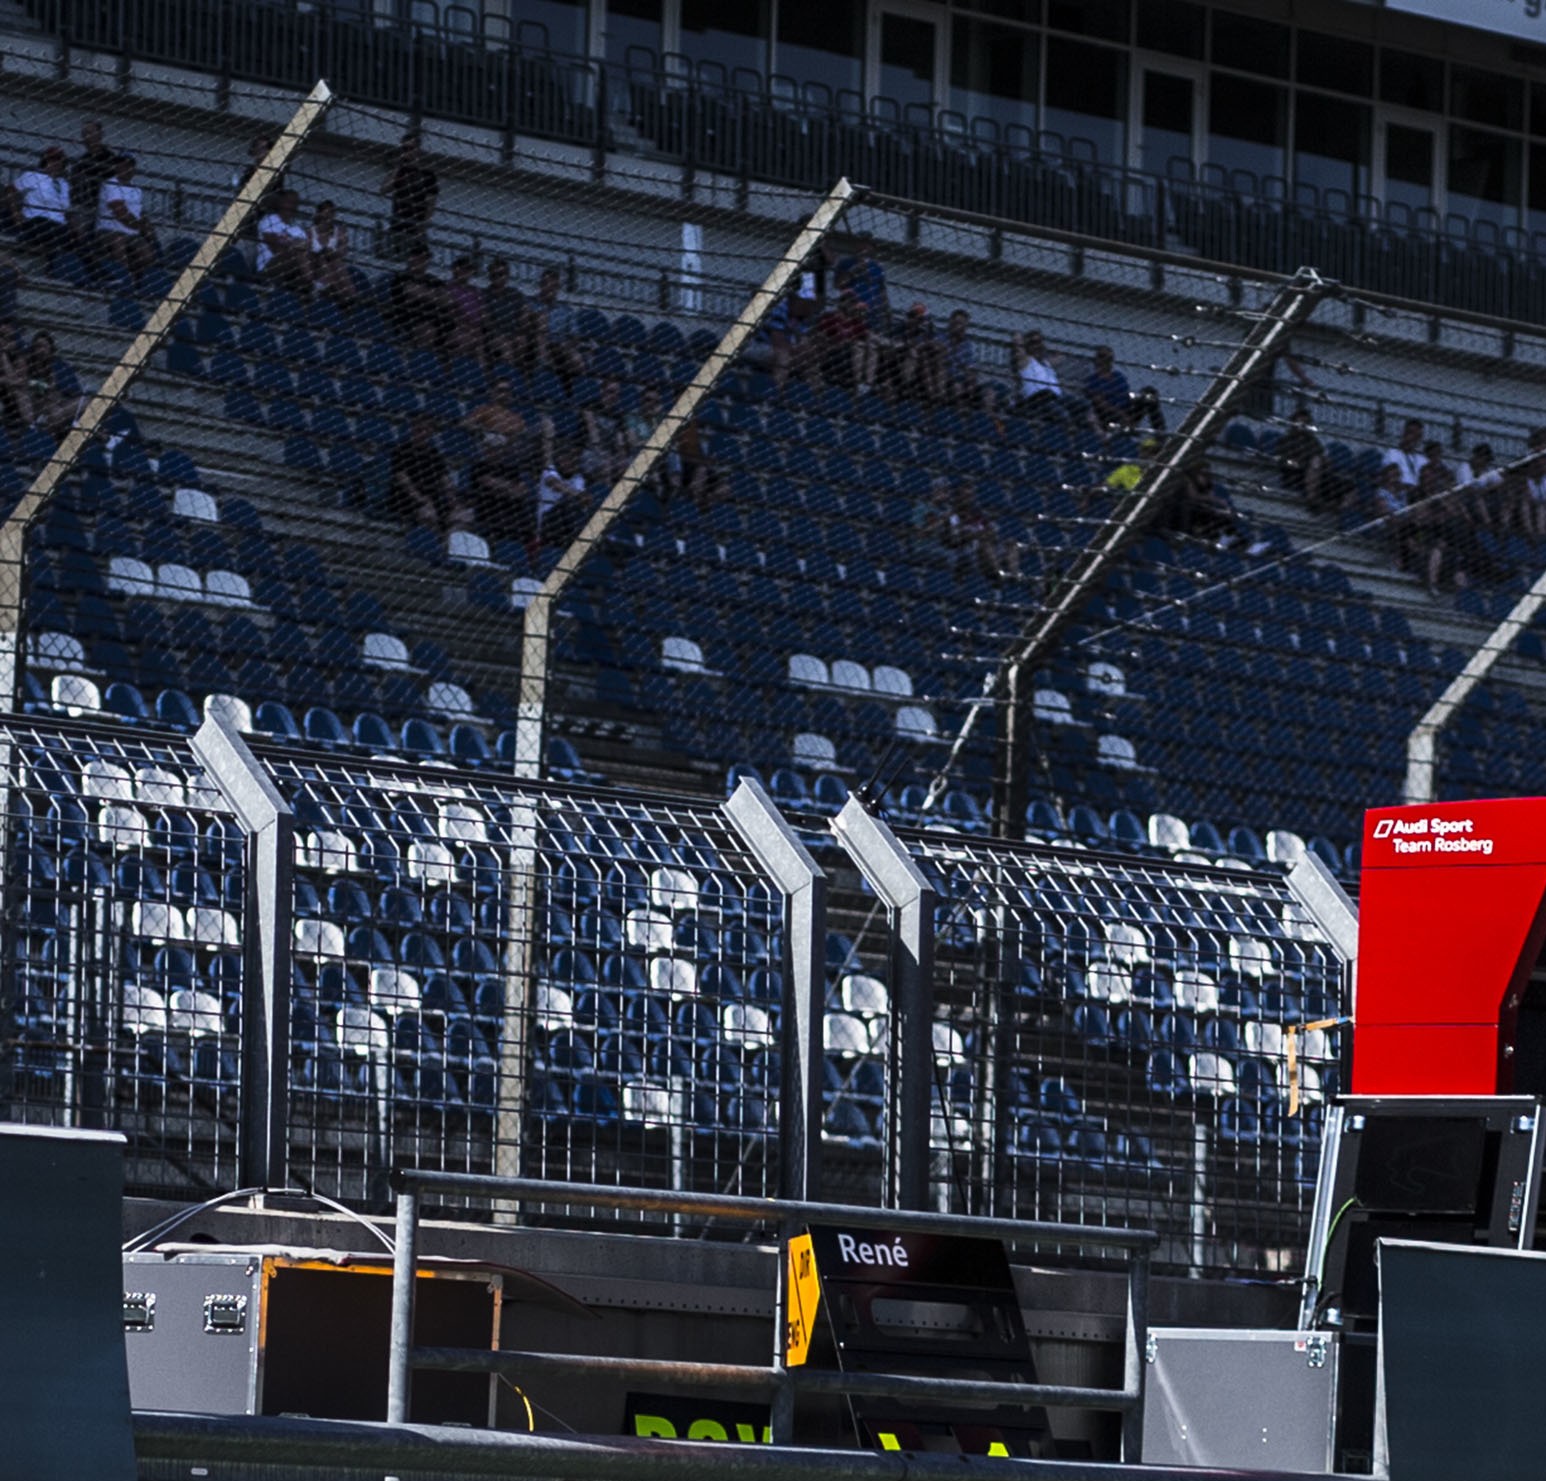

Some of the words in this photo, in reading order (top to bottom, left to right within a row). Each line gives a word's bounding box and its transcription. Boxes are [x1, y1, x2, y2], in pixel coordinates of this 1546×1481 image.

[1393, 819, 1428, 835] Audi
[1430, 818, 1474, 836] Sport
[1392, 838, 1432, 854] Team
[1434, 837, 1494, 855] Rosberg
[838, 1233, 909, 1267] René
